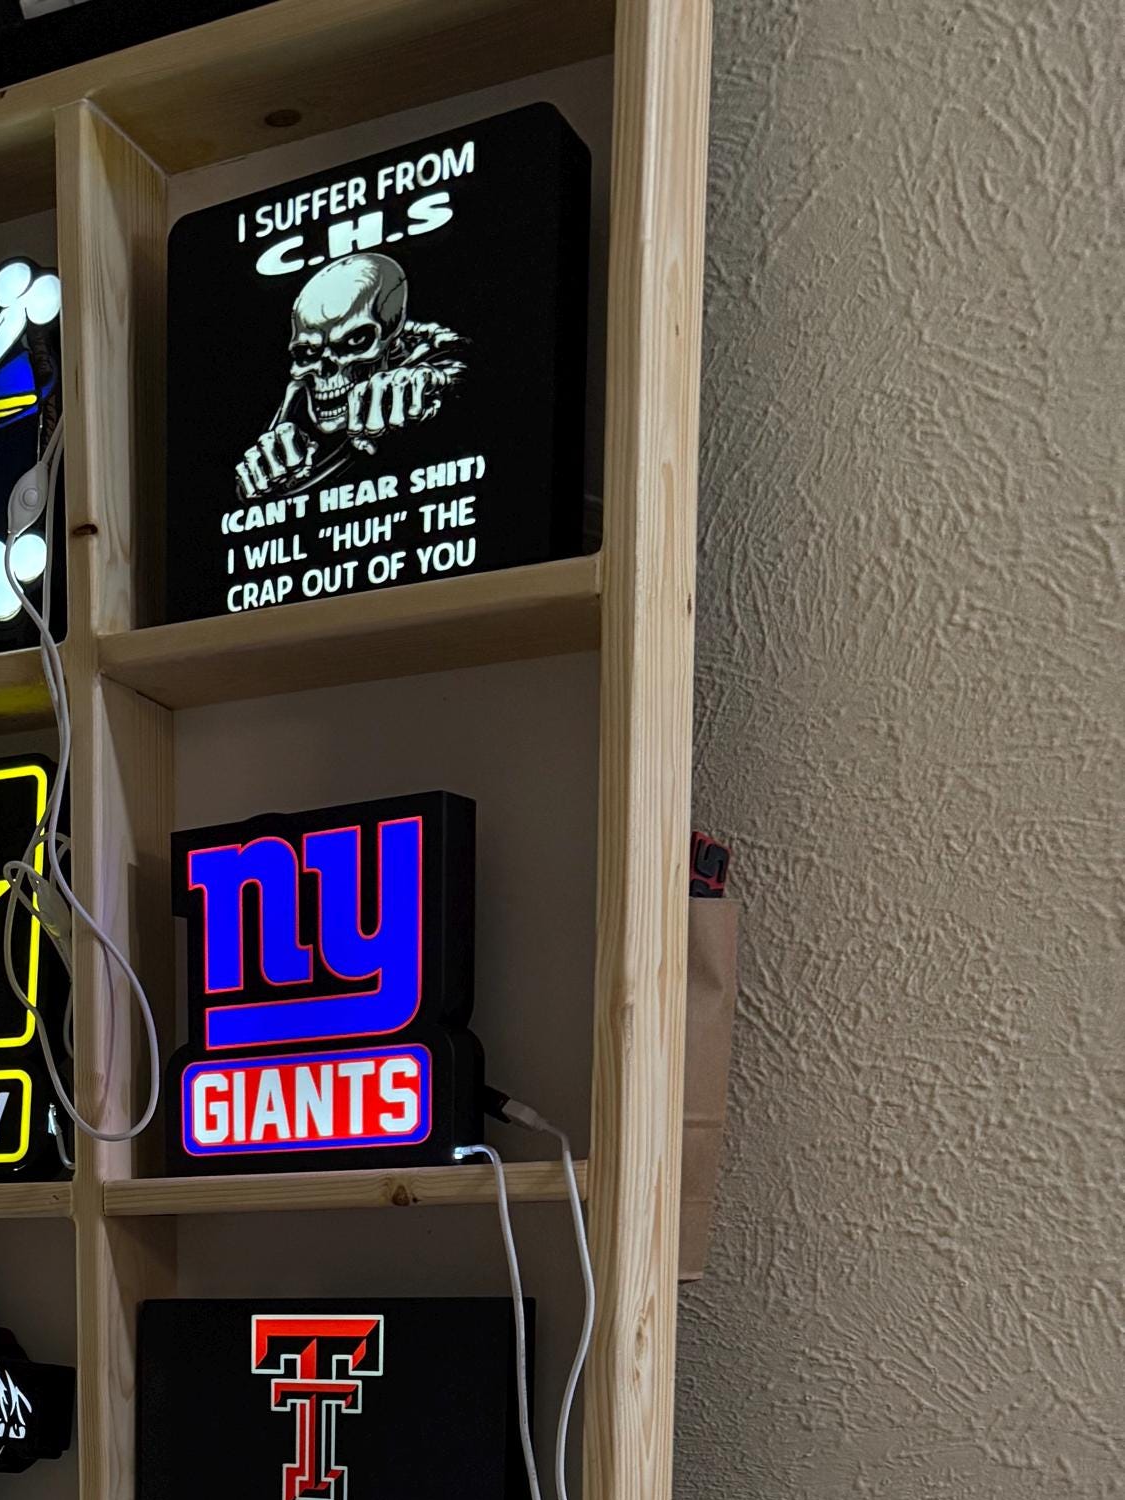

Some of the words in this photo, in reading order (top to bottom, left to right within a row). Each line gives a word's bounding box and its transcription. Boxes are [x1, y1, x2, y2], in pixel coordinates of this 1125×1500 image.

[237, 212, 246, 243] I
[255, 176, 367, 238] SUFFER
[376, 141, 476, 201] FROM
[255, 191, 454, 276] C.H.S
[221, 495, 310, 535] (CAN'T
[319, 474, 399, 513] HEAR
[409, 455, 486, 493] SHIT)
[227, 549, 234, 574] I
[244, 534, 308, 571] WILL
[317, 511, 408, 553] "HUH"
[418, 496, 476, 535] THE
[226, 572, 293, 613] CRAP
[302, 561, 359, 598] OUT
[367, 551, 405, 585] OF
[417, 537, 476, 579] YOU
[192, 1057, 419, 1144] GIANTS
